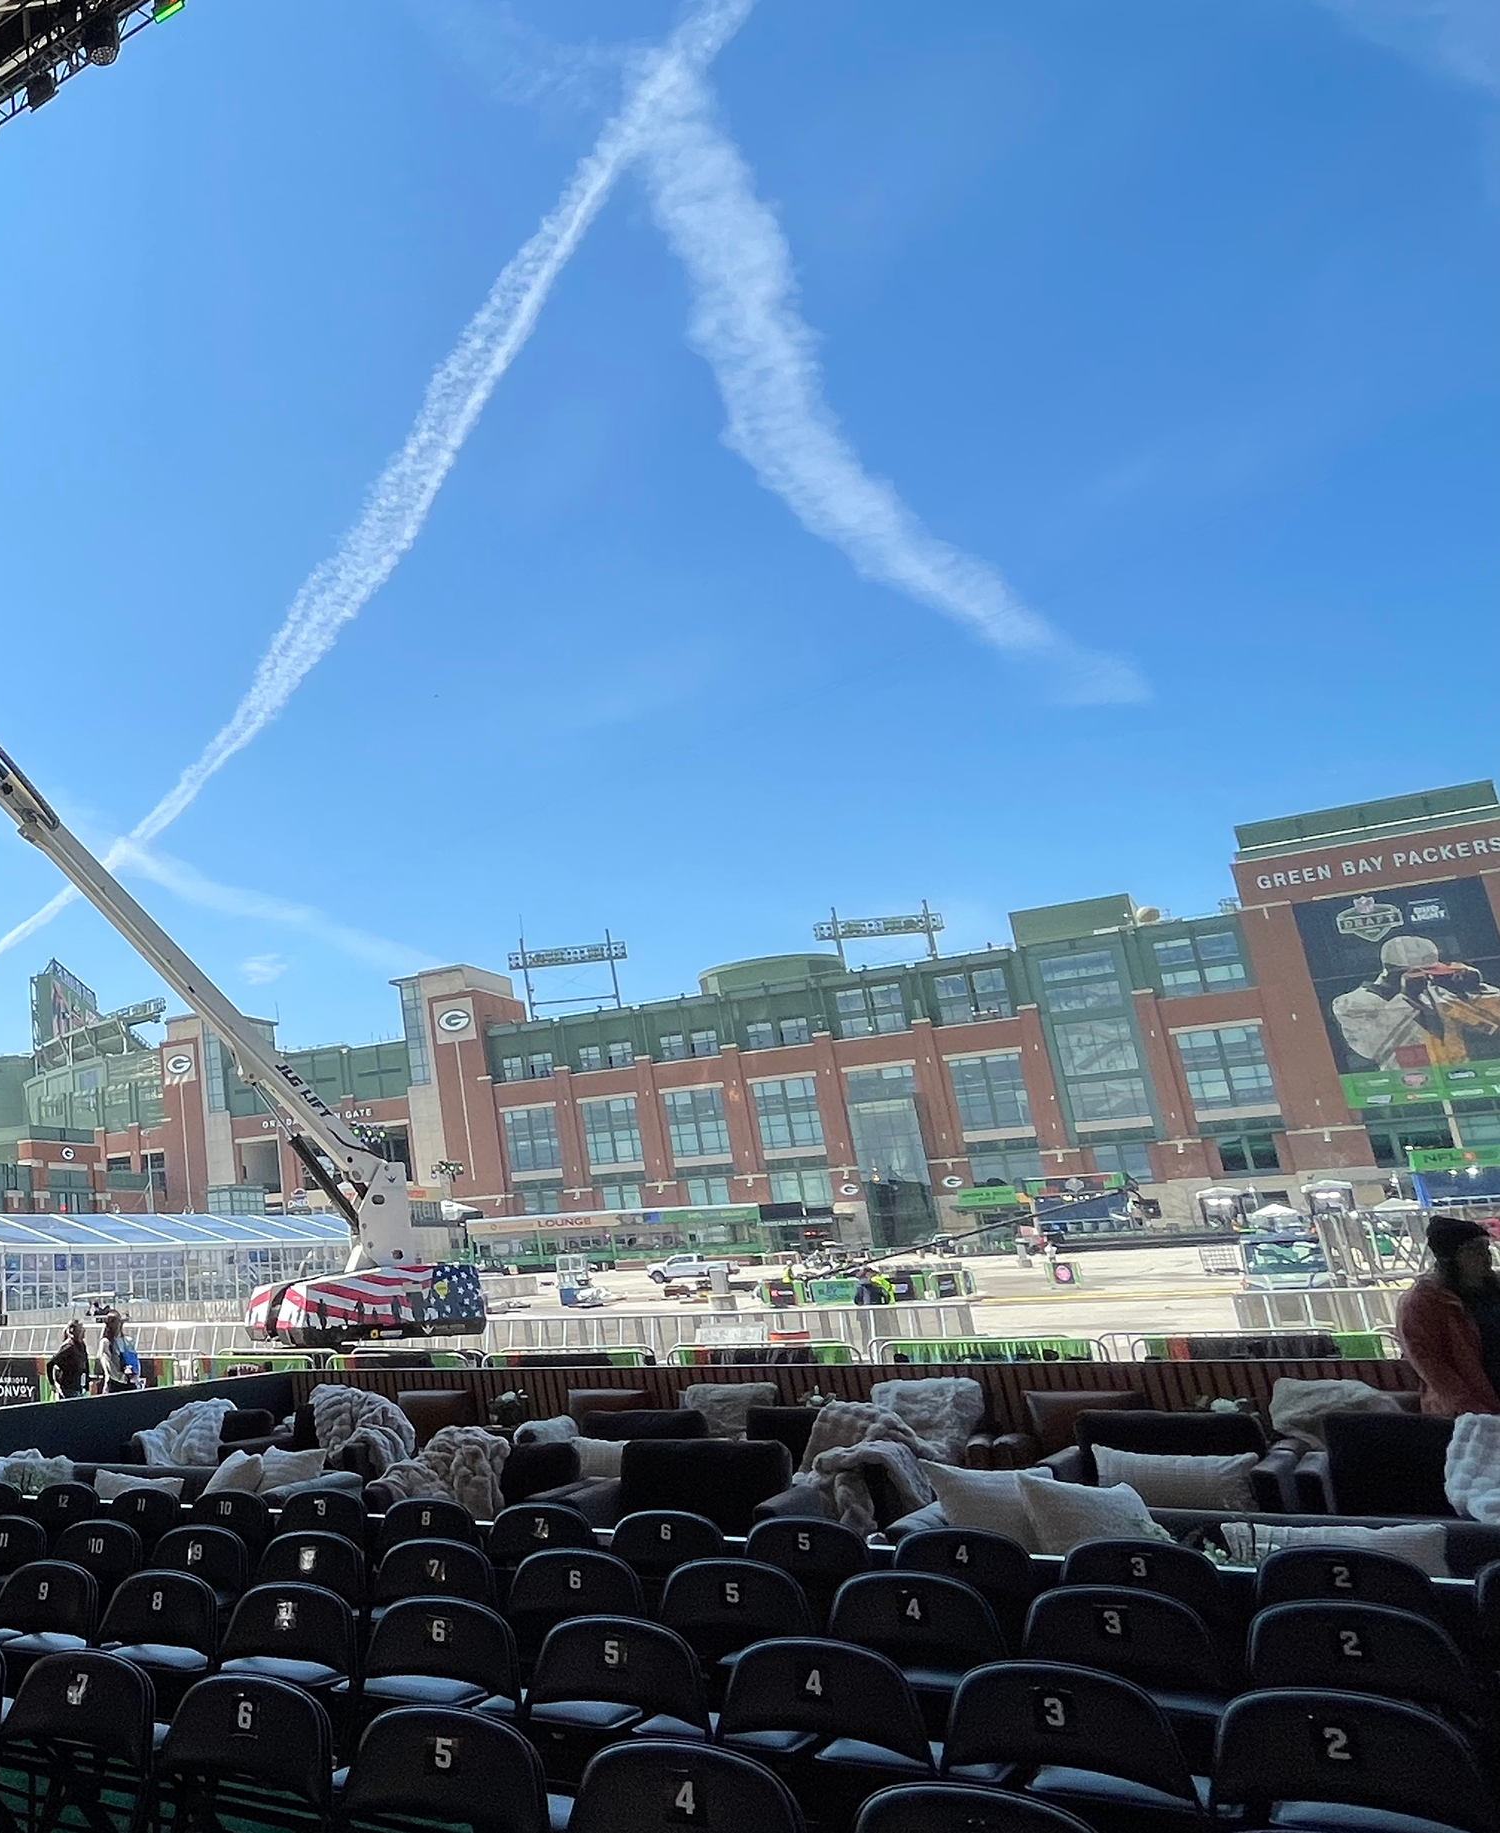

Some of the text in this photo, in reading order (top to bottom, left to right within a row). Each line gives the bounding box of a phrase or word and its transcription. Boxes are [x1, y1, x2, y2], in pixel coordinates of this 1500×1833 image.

[1256, 837, 1500, 890] GREEN BAY PACKERS
[1343, 914, 1396, 929] DRAFT
[438, 1008, 471, 1031] G
[166, 1055, 192, 1074] G
[275, 1064, 333, 1117] JLG LIFT
[345, 1108, 372, 1119] GATE
[1423, 1151, 1461, 1164] NFL
[537, 1216, 592, 1229] LOUNGE
[58, 1494, 70, 1508] 12
[136, 1497, 146, 1512] 11
[219, 1500, 233, 1516] 10
[421, 1510, 431, 1526] 8
[0, 1532, 9, 1548] 11
[660, 1523, 672, 1541] 6
[798, 1532, 810, 1551] 5
[90, 1537, 104, 1554] 10
[955, 1544, 969, 1564] 4
[1130, 1556, 1147, 1577] 3
[569, 1570, 582, 1589] 6
[1332, 1566, 1352, 1588] 2
[38, 1581, 49, 1601] 9
[151, 1591, 163, 1611] 8
[725, 1582, 740, 1603] 5
[906, 1597, 921, 1620] 4
[431, 1619, 446, 1642] 6
[1103, 1610, 1122, 1634] 3
[604, 1640, 619, 1665] 5
[1339, 1630, 1363, 1657] 2
[805, 1669, 823, 1696] 4
[237, 1701, 253, 1730] 6
[1043, 1697, 1065, 1727] 3
[434, 1736, 453, 1769] 5
[1323, 1727, 1352, 1760] 2
[675, 1781, 696, 1815] 4
